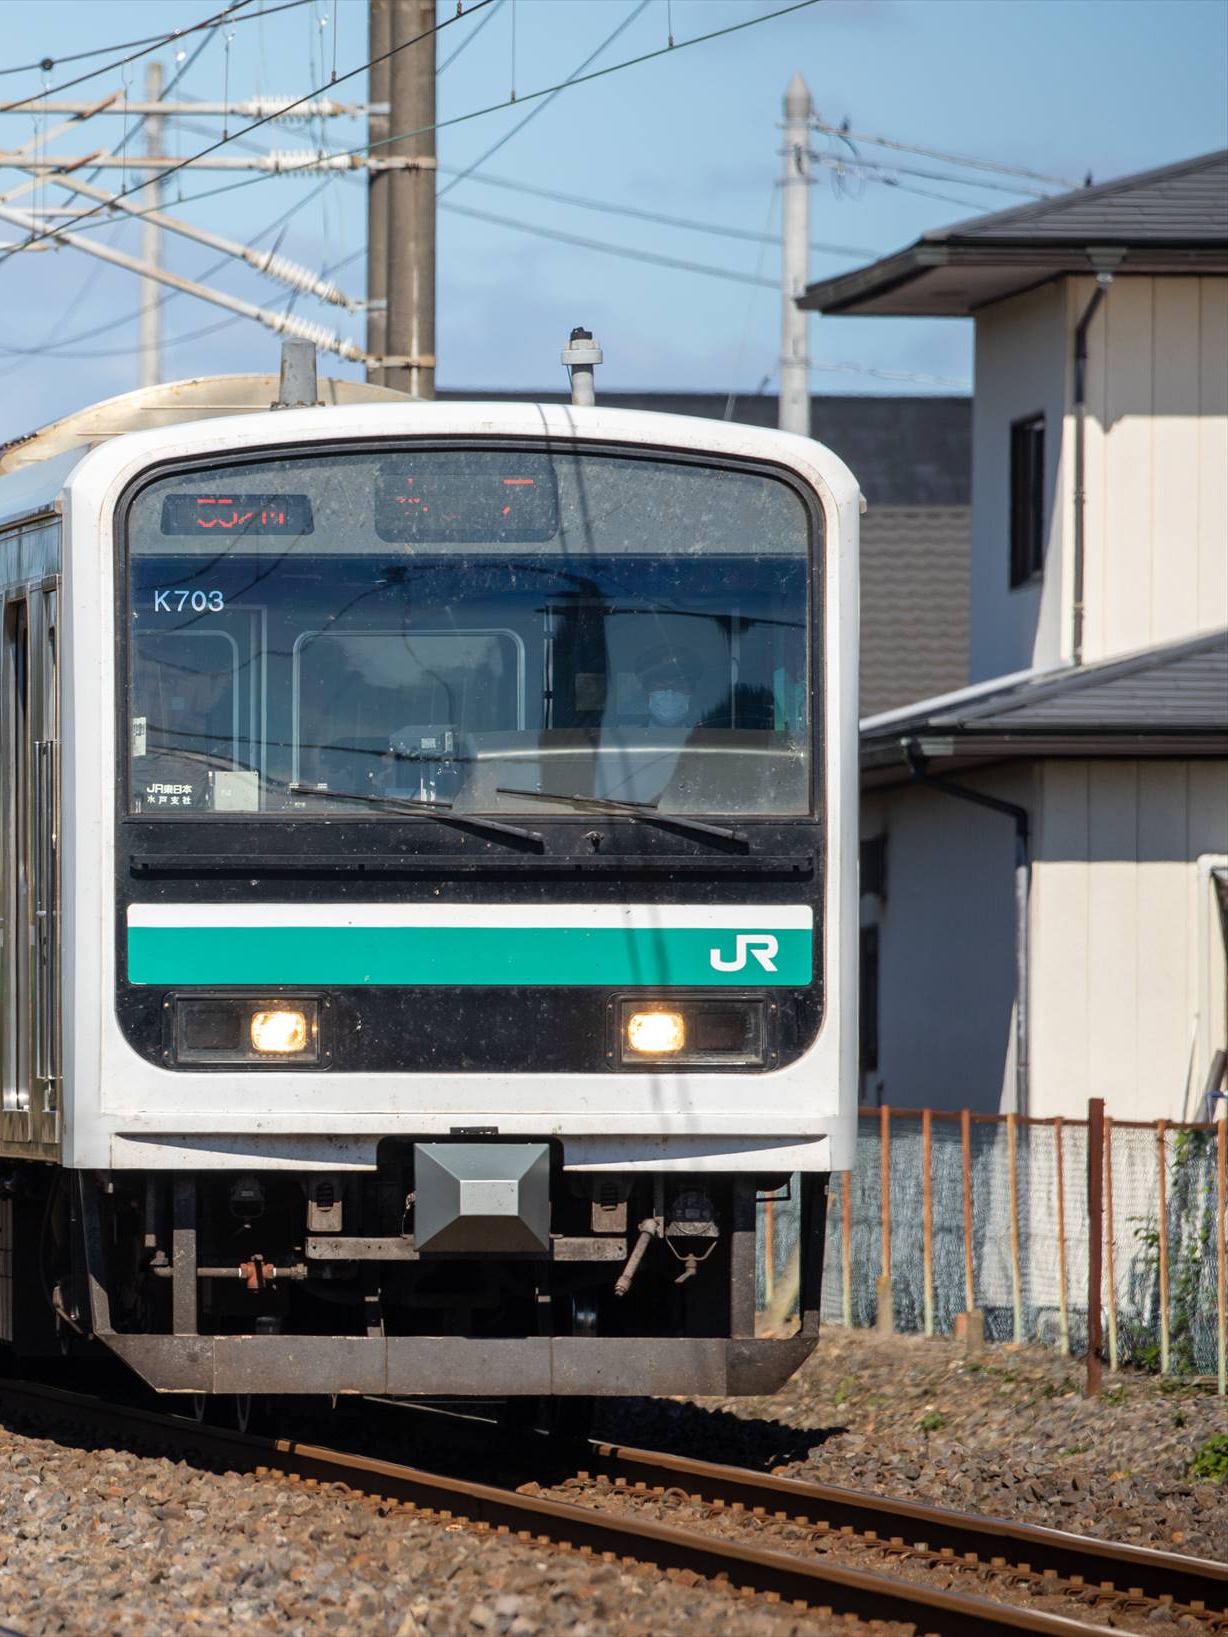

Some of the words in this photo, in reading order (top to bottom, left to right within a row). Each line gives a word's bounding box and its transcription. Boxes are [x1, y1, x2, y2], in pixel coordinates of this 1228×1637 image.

[154, 590, 225, 612] K703
[146, 783, 193, 795] JR東日本
[147, 795, 192, 805] 水戸支社
[710, 934, 779, 972] JR
